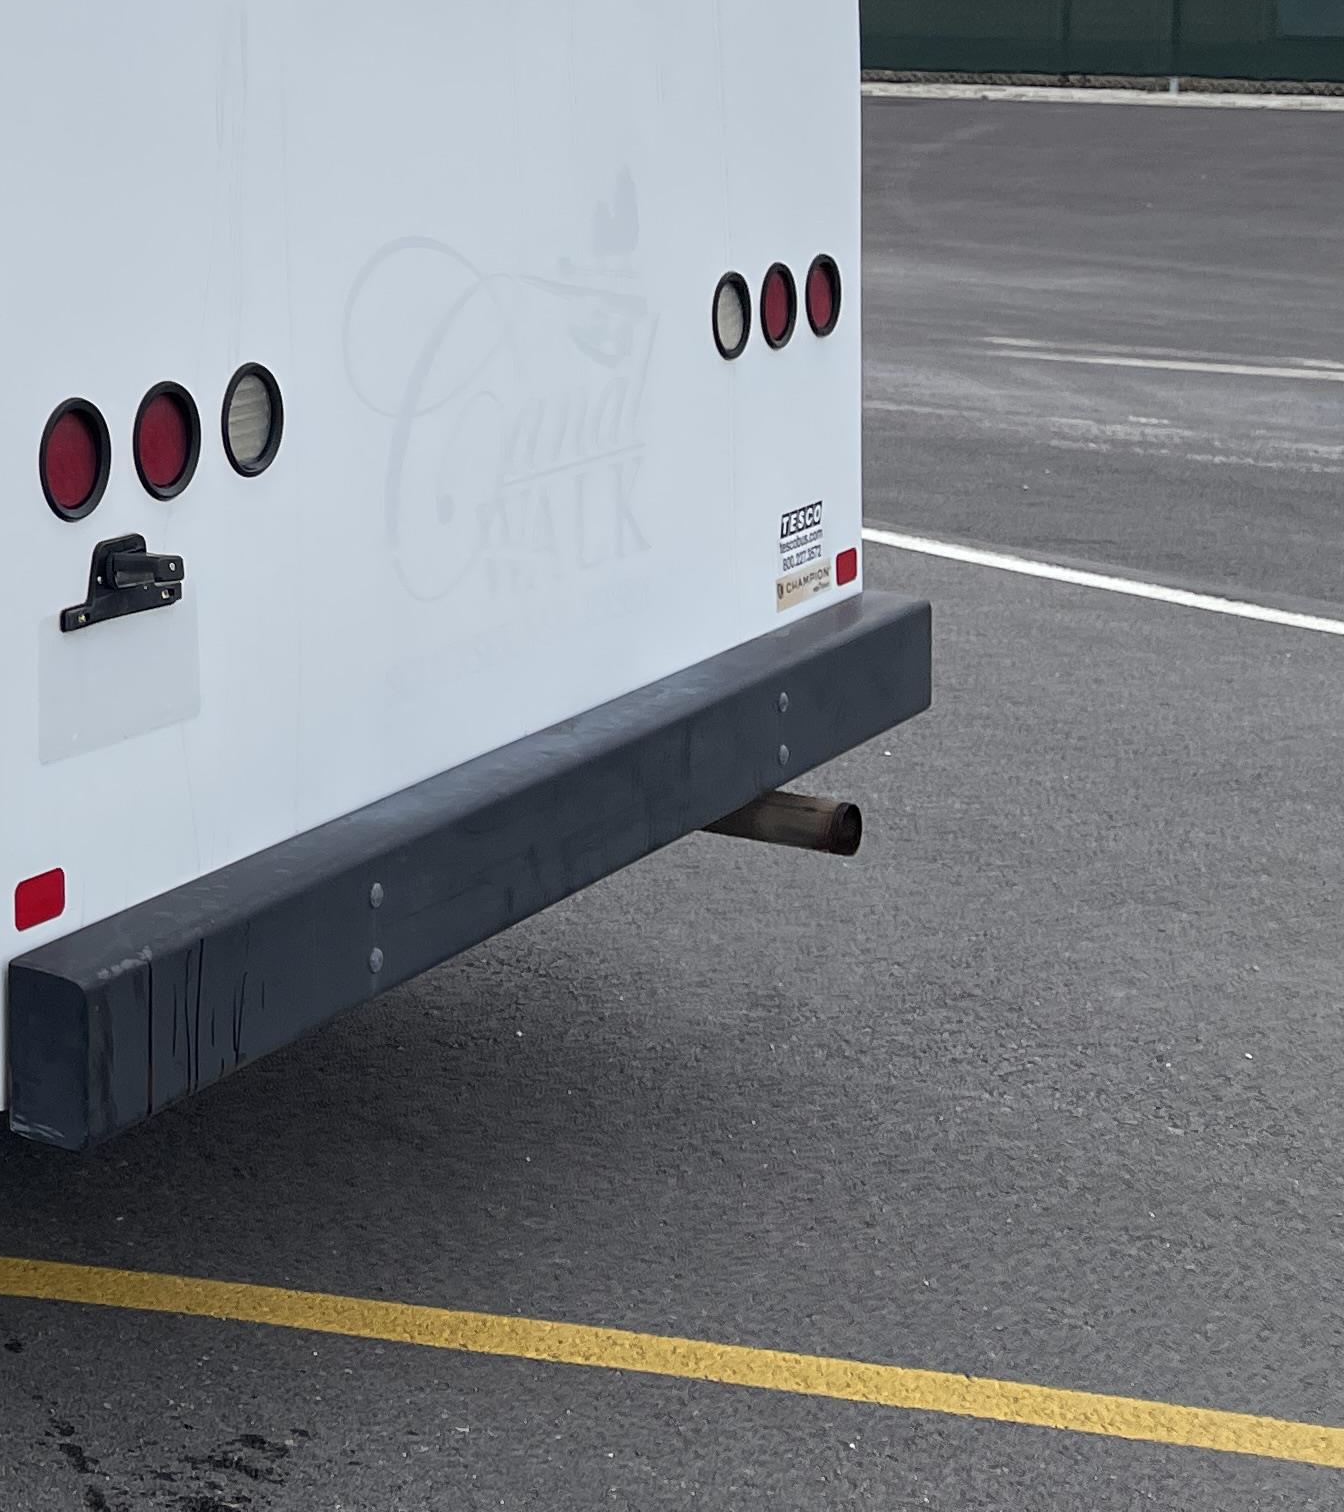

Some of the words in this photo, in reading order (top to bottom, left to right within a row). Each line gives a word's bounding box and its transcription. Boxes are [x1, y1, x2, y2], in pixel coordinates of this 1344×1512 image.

[781, 503, 822, 536] TESCO
[779, 529, 824, 554] tescobus.com
[786, 567, 830, 594] CHAMPION
